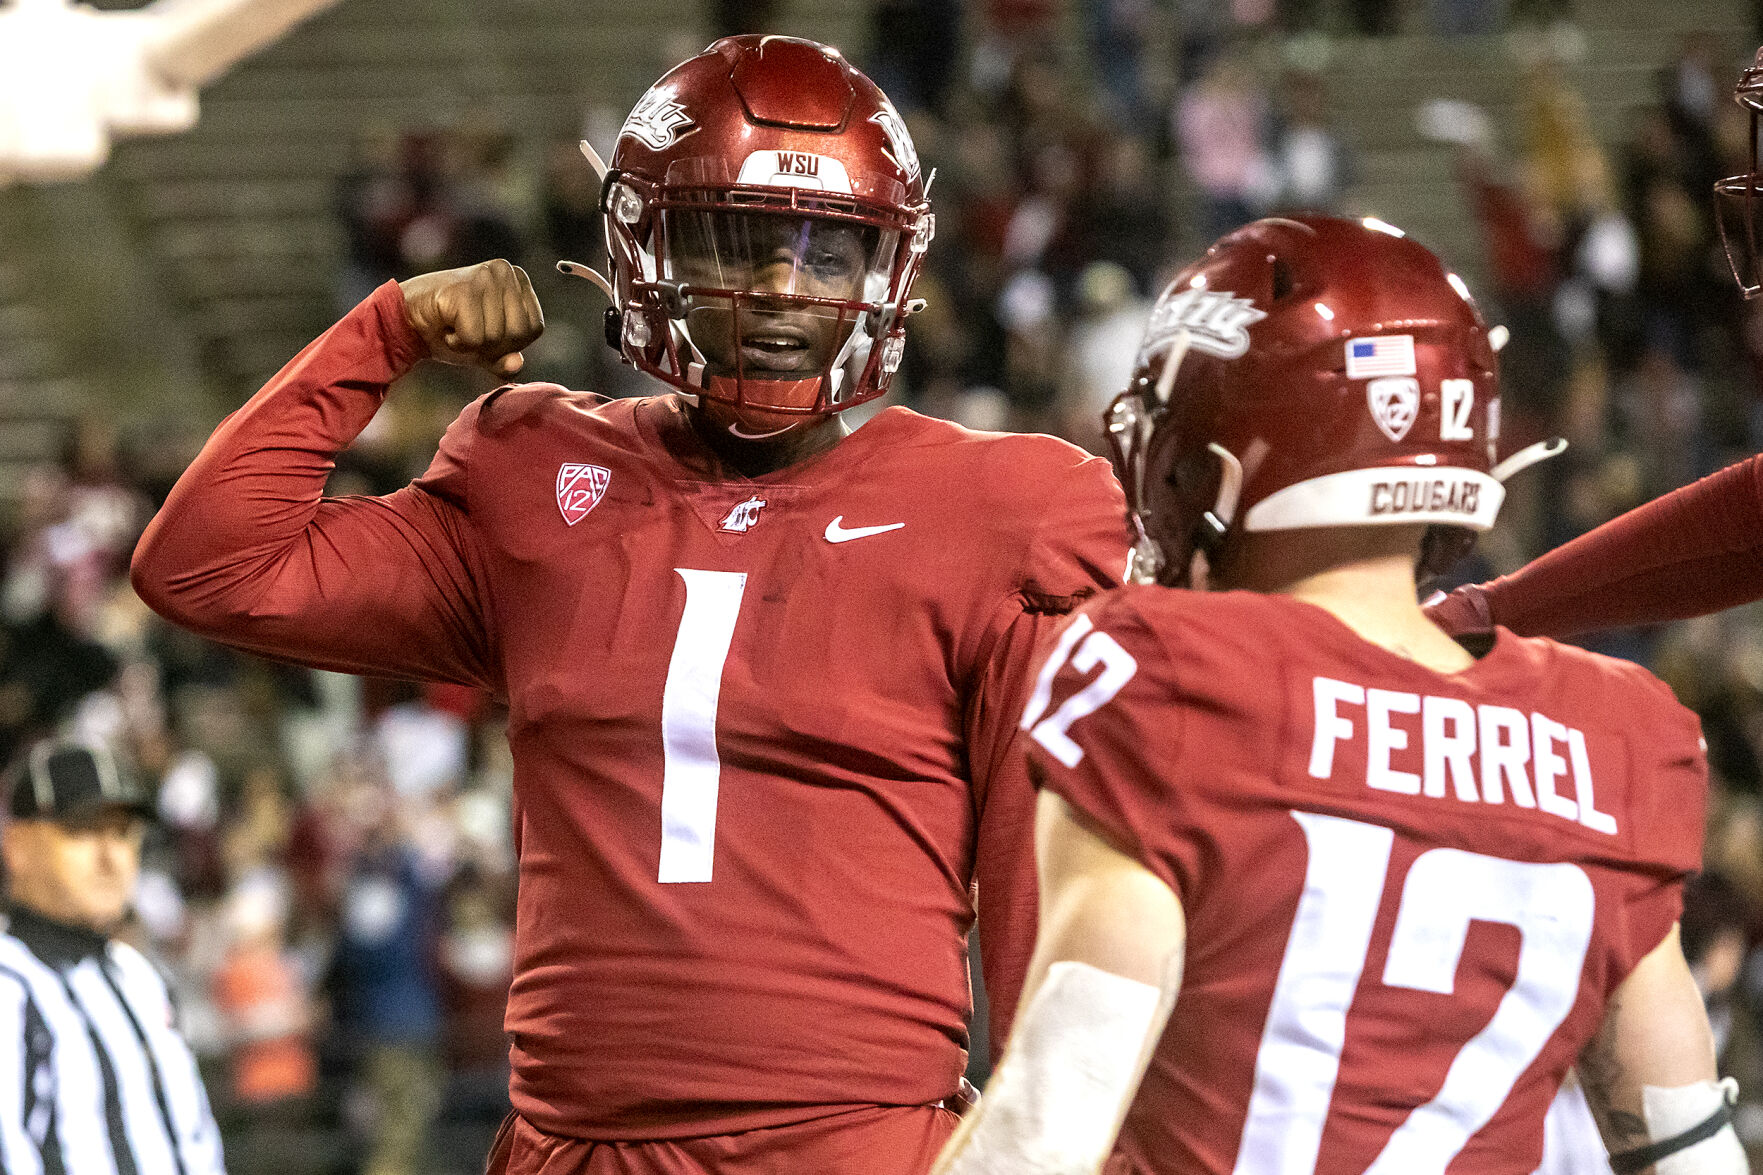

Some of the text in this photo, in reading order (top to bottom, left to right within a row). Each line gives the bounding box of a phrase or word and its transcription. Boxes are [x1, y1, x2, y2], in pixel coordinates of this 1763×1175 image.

[777, 152, 819, 176] WSU
[1440, 378, 1474, 440] 12
[560, 465, 608, 502] PAC
[564, 489, 591, 511] 12
[1369, 480, 1481, 515] COUGARS
[1020, 613, 1138, 768] 12
[657, 568, 748, 883] 1
[1308, 676, 1618, 835] FERREL
[1232, 810, 1595, 1175] 12
